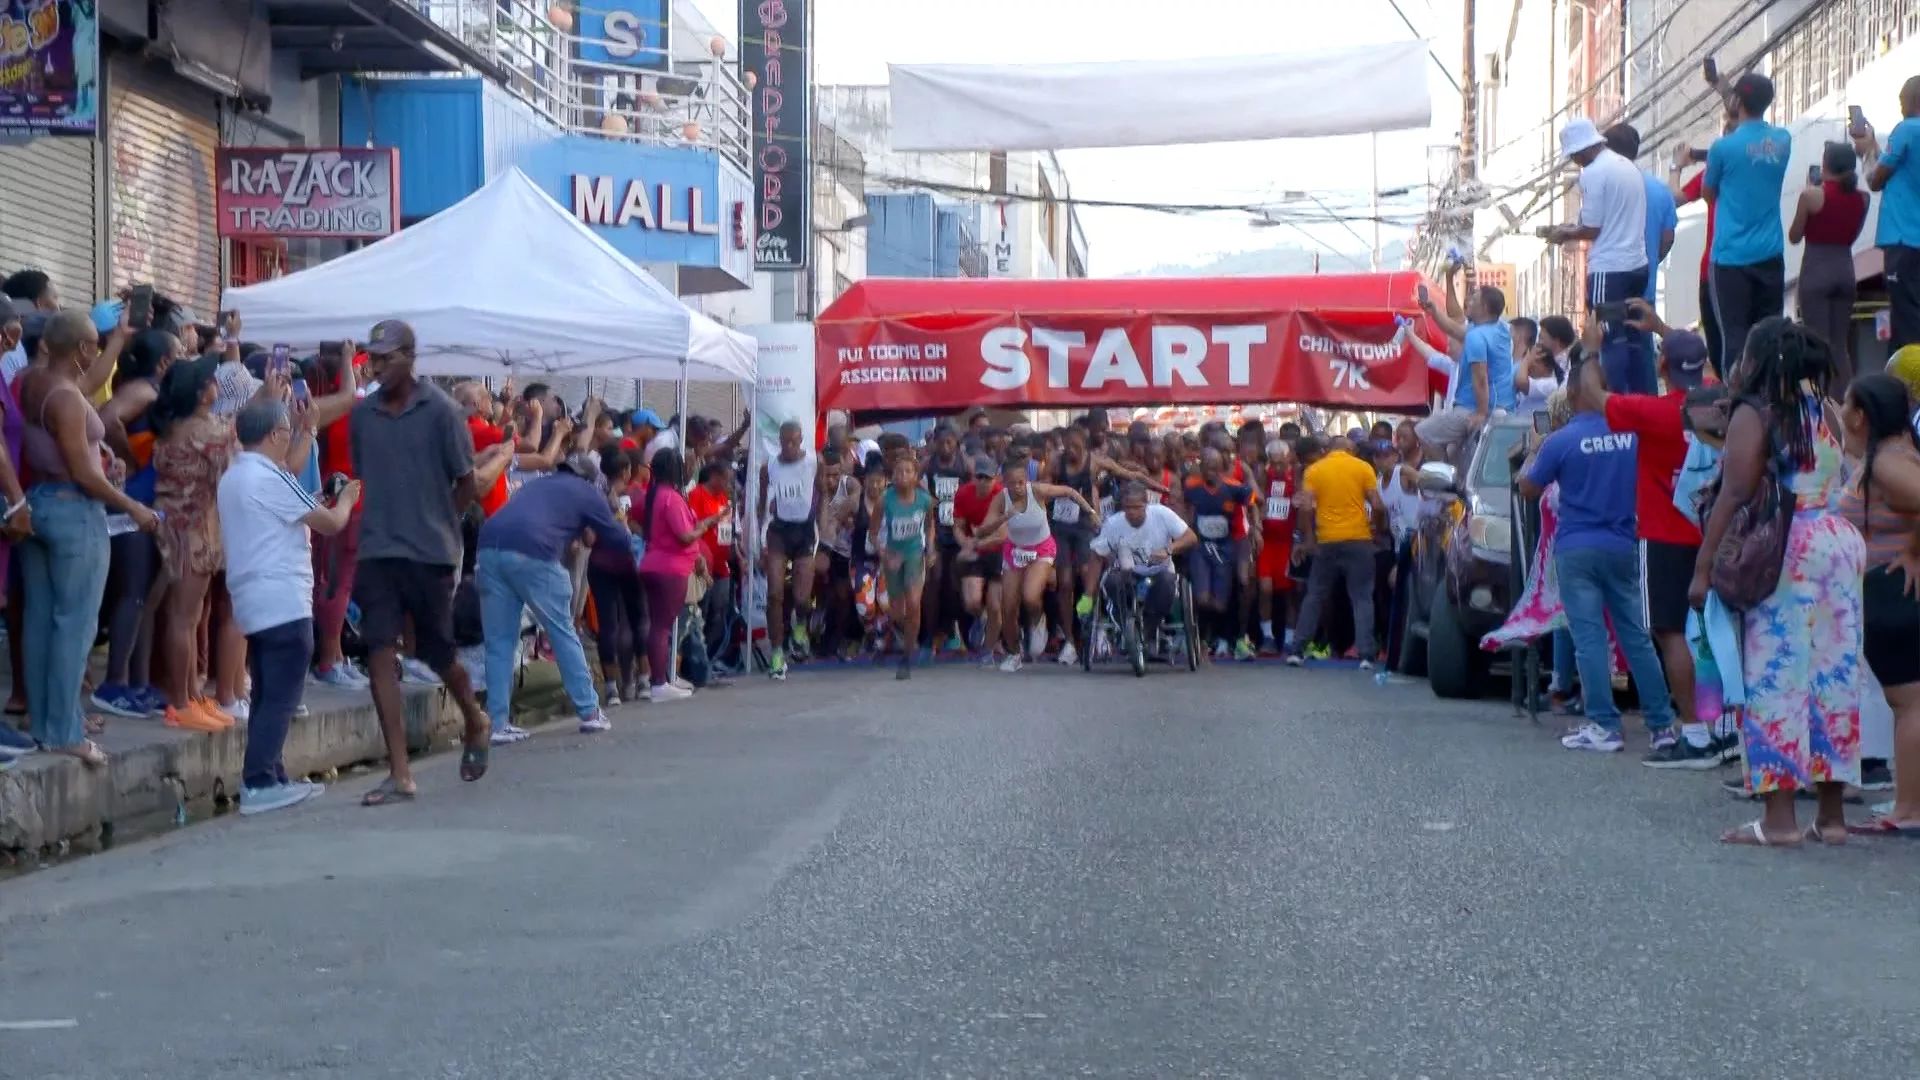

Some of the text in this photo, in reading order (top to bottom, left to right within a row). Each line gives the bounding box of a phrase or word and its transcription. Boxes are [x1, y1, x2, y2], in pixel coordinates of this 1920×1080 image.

[603, 10, 640, 57] S
[230, 152, 377, 205] RAZACK
[571, 173, 719, 234] MALL
[229, 206, 383, 231] TRADING
[924, 343, 948, 359] ON
[979, 324, 1267, 390] START
[1299, 334, 1402, 360] CHINATOWN
[840, 365, 947, 385] ASSOCIATION
[1328, 358, 1372, 391] 7K
[1580, 433, 1632, 454] CREW
